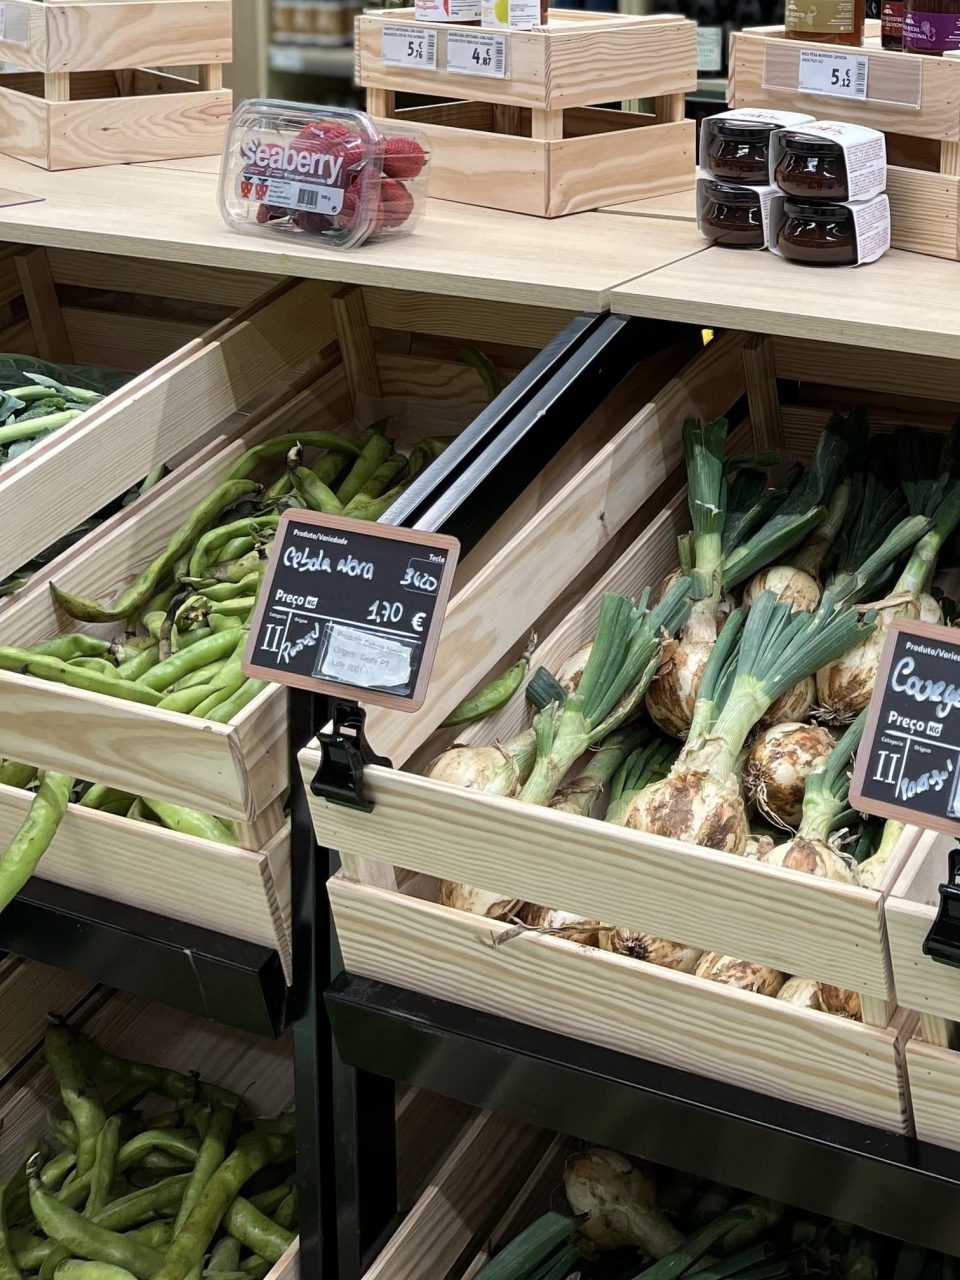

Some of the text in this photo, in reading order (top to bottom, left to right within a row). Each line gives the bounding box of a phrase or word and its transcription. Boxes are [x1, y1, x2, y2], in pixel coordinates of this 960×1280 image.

[293, 528, 349, 546] Produto/Variedade
[429, 554, 446, 564] Tecla
[275, 589, 304, 608] Preço
[412, 612, 427, 632] €
[260, 623, 284, 652] II
[888, 710, 942, 736] Preço KG
[872, 750, 901, 785] II
